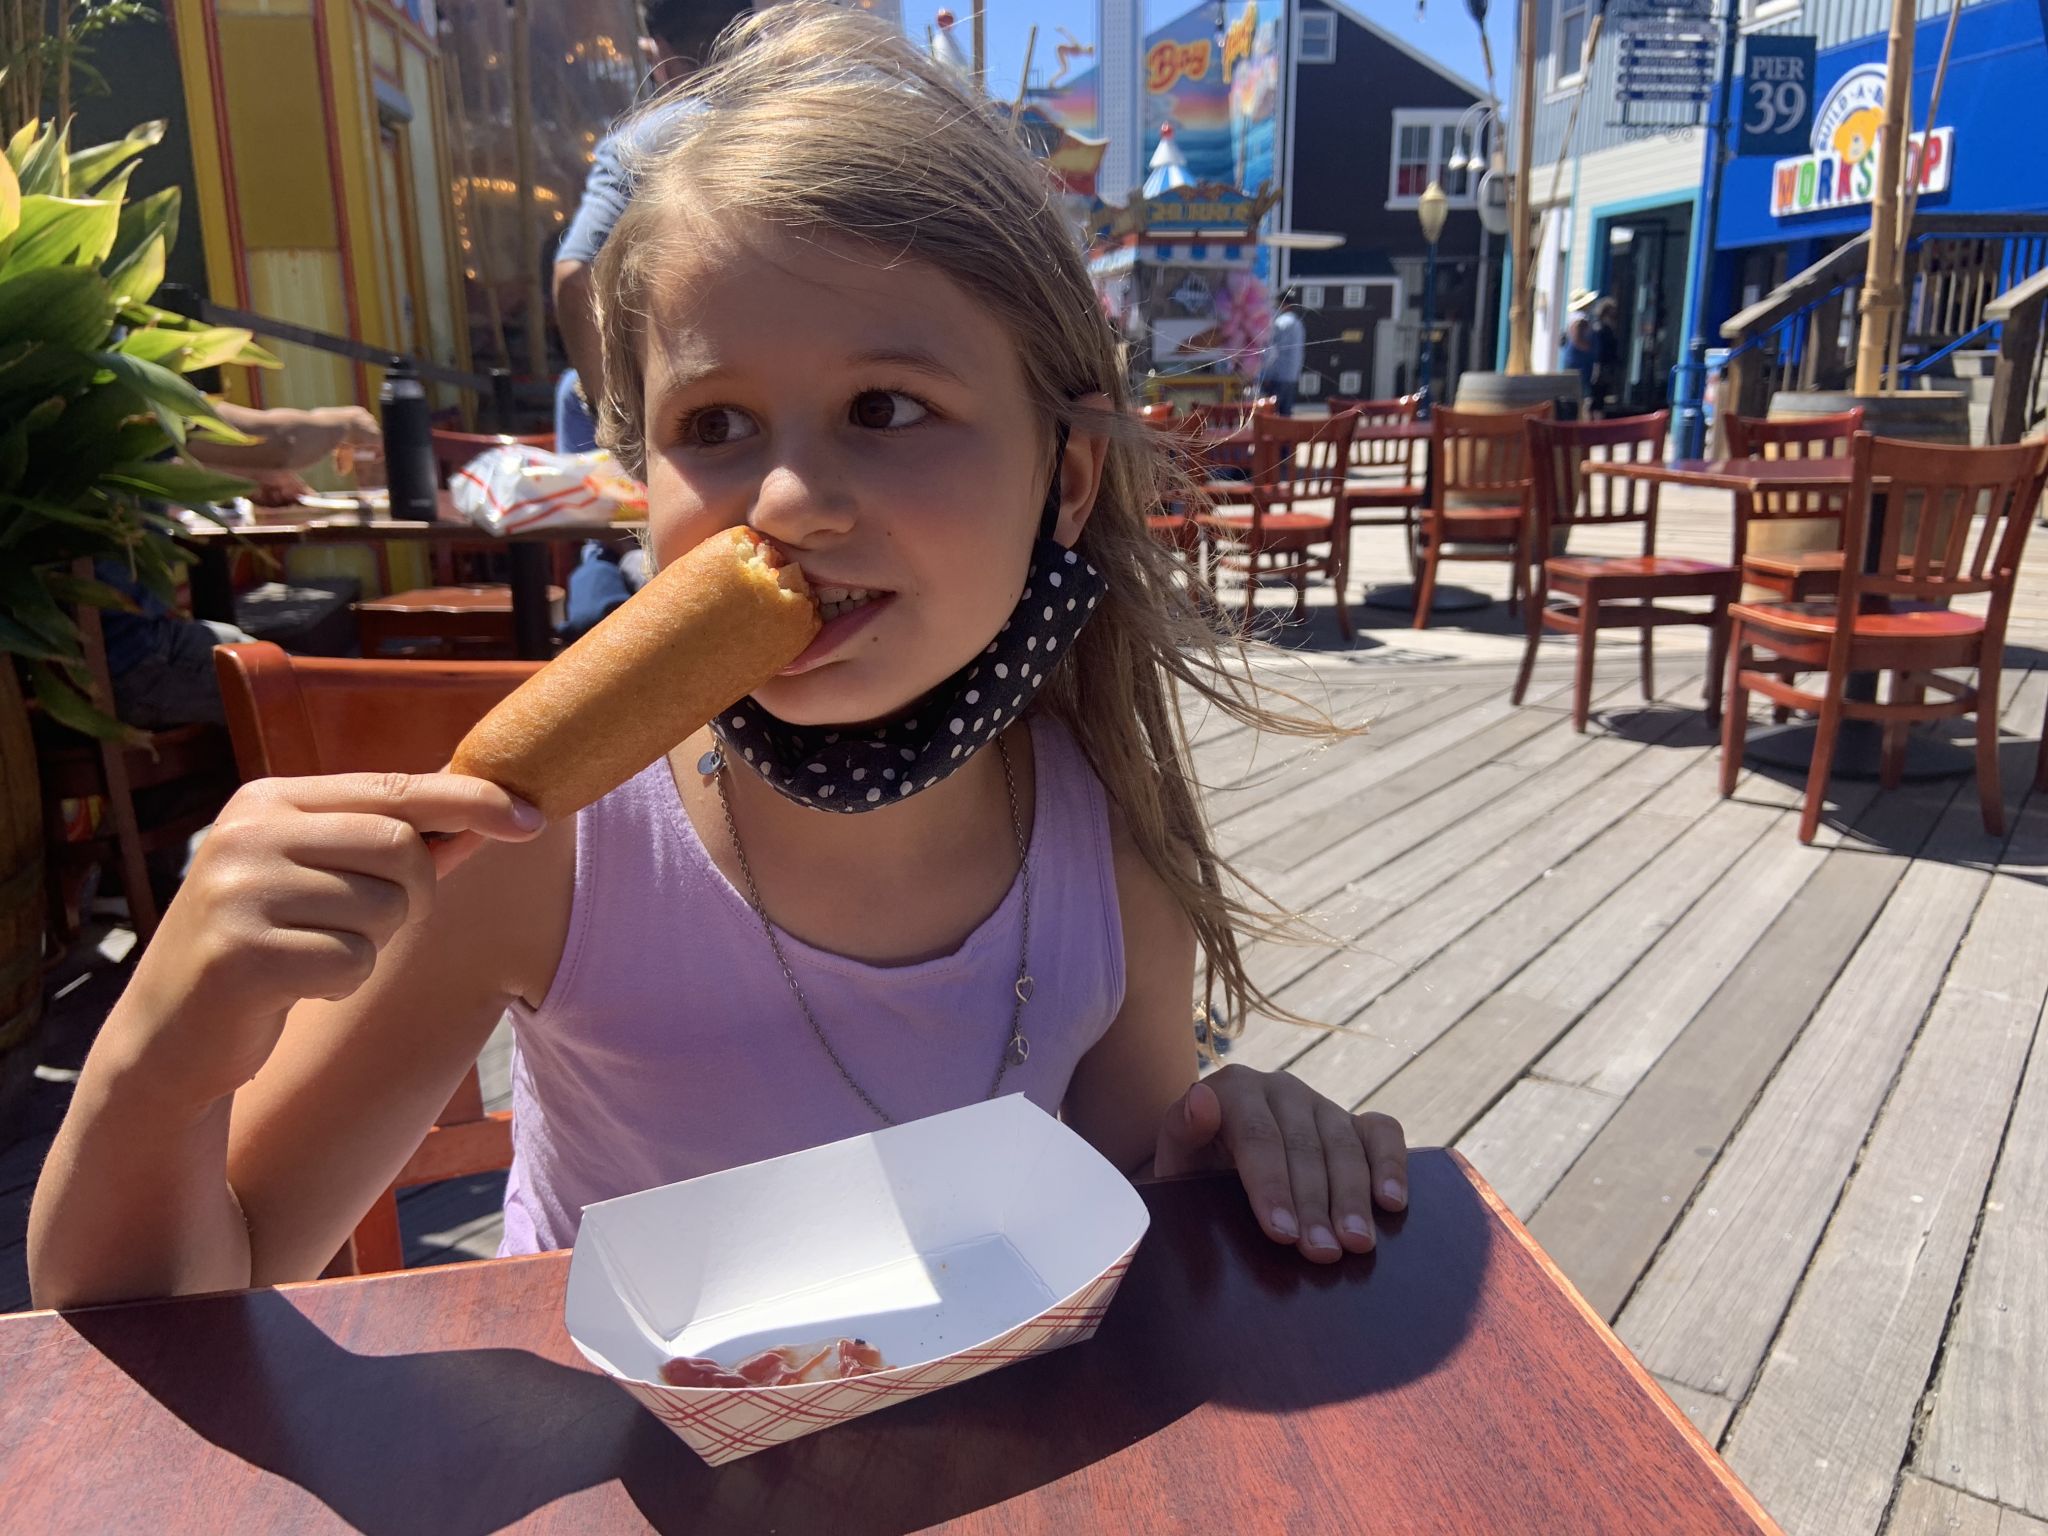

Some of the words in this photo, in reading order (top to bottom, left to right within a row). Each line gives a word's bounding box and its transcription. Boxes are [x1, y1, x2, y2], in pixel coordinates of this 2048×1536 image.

[1147, 41, 1209, 92] Bay
[1751, 56, 1804, 80] PIER
[1744, 81, 1807, 134] 39
[1776, 137, 1942, 210] WORKSOP
